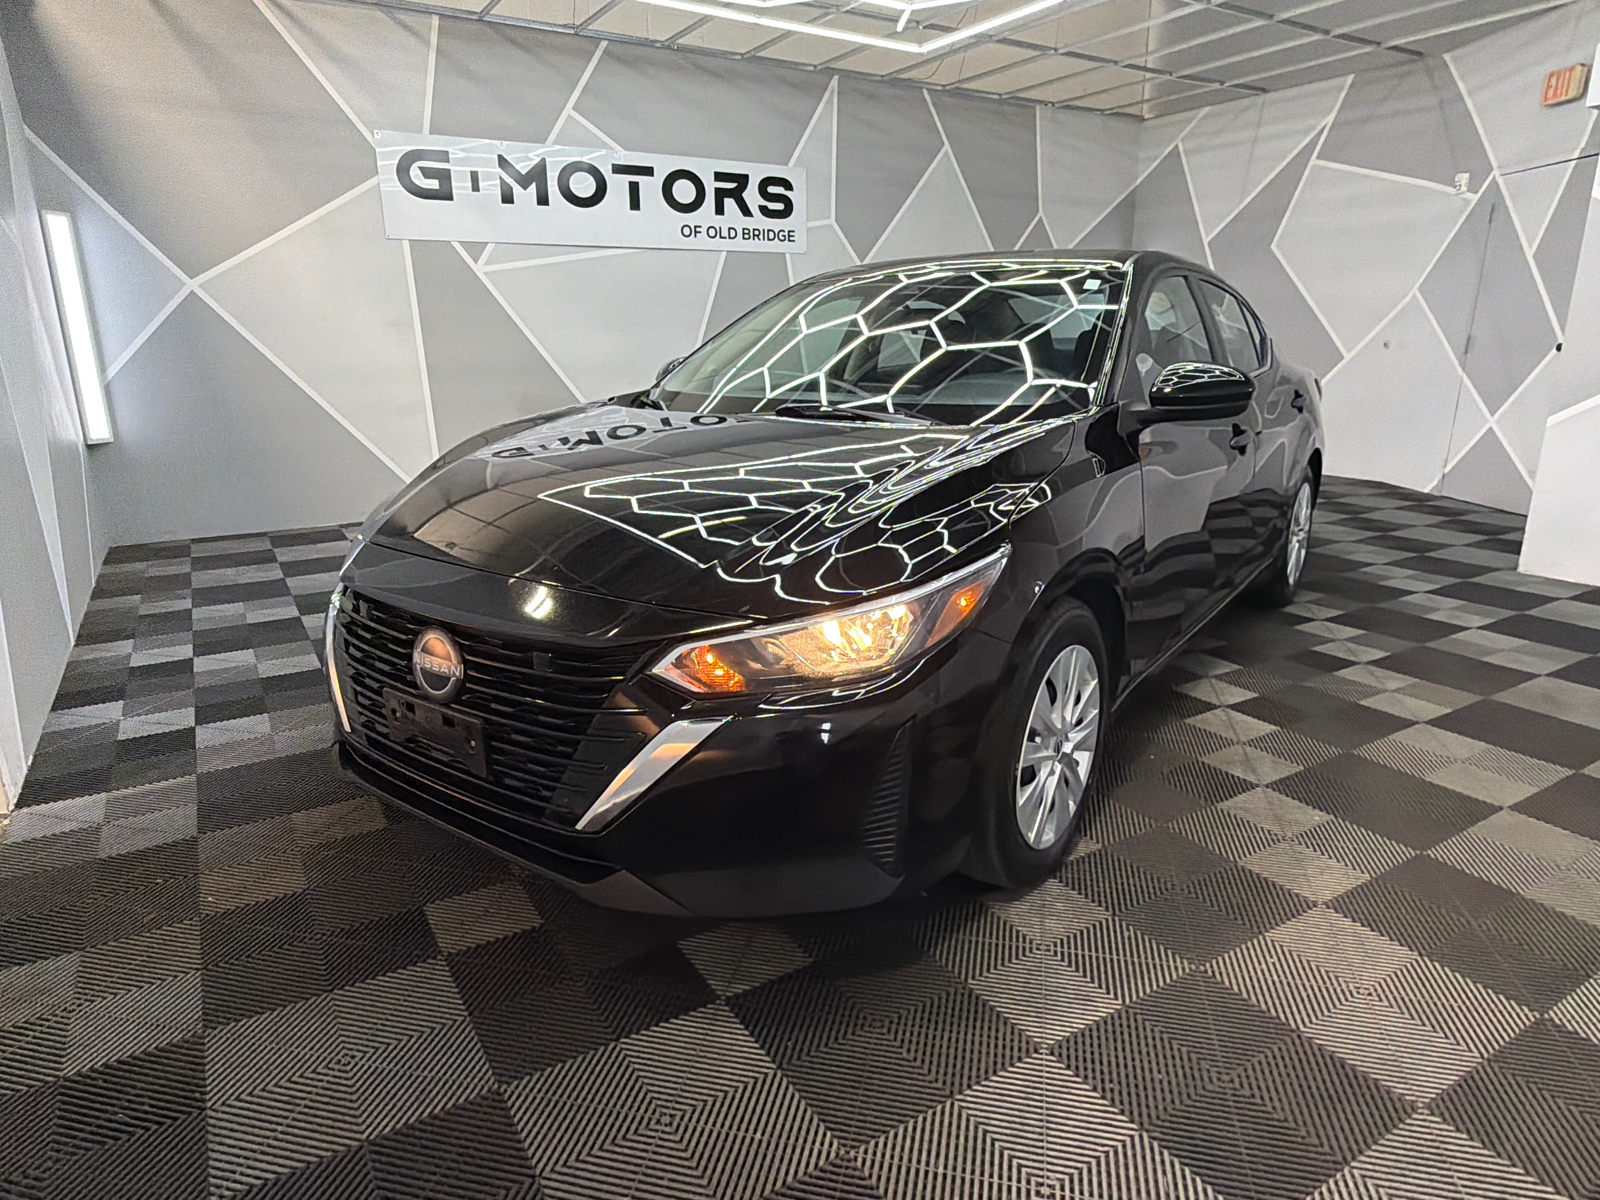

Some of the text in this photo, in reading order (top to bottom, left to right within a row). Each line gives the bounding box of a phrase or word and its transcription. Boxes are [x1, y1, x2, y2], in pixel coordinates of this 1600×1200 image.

[1543, 66, 1576, 103] EXIT
[680, 224, 796, 243] OF OLD BRIDGE
[413, 651, 461, 677] NISSAN
